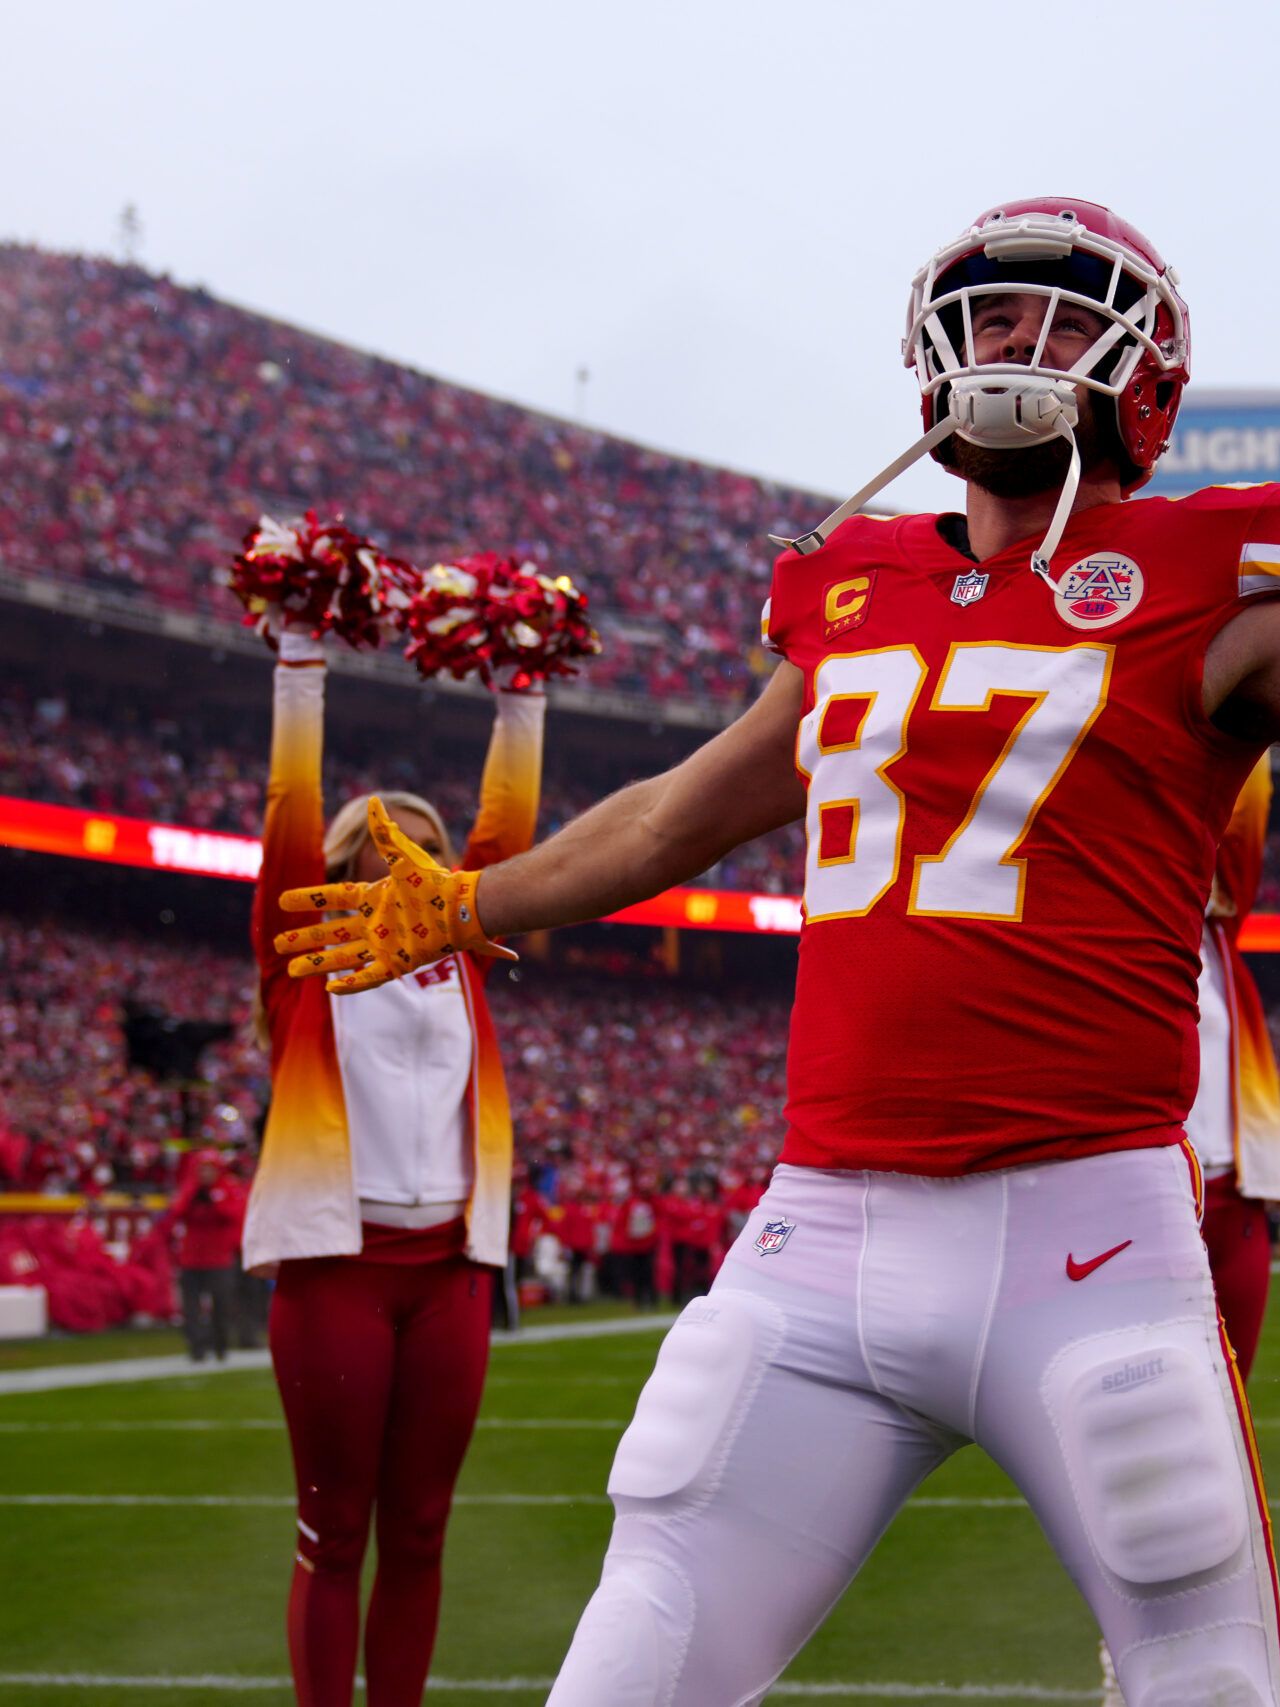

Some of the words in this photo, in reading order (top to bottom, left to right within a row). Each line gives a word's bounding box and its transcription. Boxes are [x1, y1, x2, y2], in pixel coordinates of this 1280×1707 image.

[825, 576, 870, 623] C
[956, 585, 979, 599] NFL
[795, 641, 1116, 925] 87
[407, 872, 423, 888] 87
[310, 892, 327, 909] 87
[430, 895, 445, 911] 87
[359, 902, 374, 918] 87
[374, 924, 389, 939] 87
[412, 923, 429, 938] 87
[758, 1232, 780, 1248] NFL
[1102, 1357, 1164, 1391] schutt
